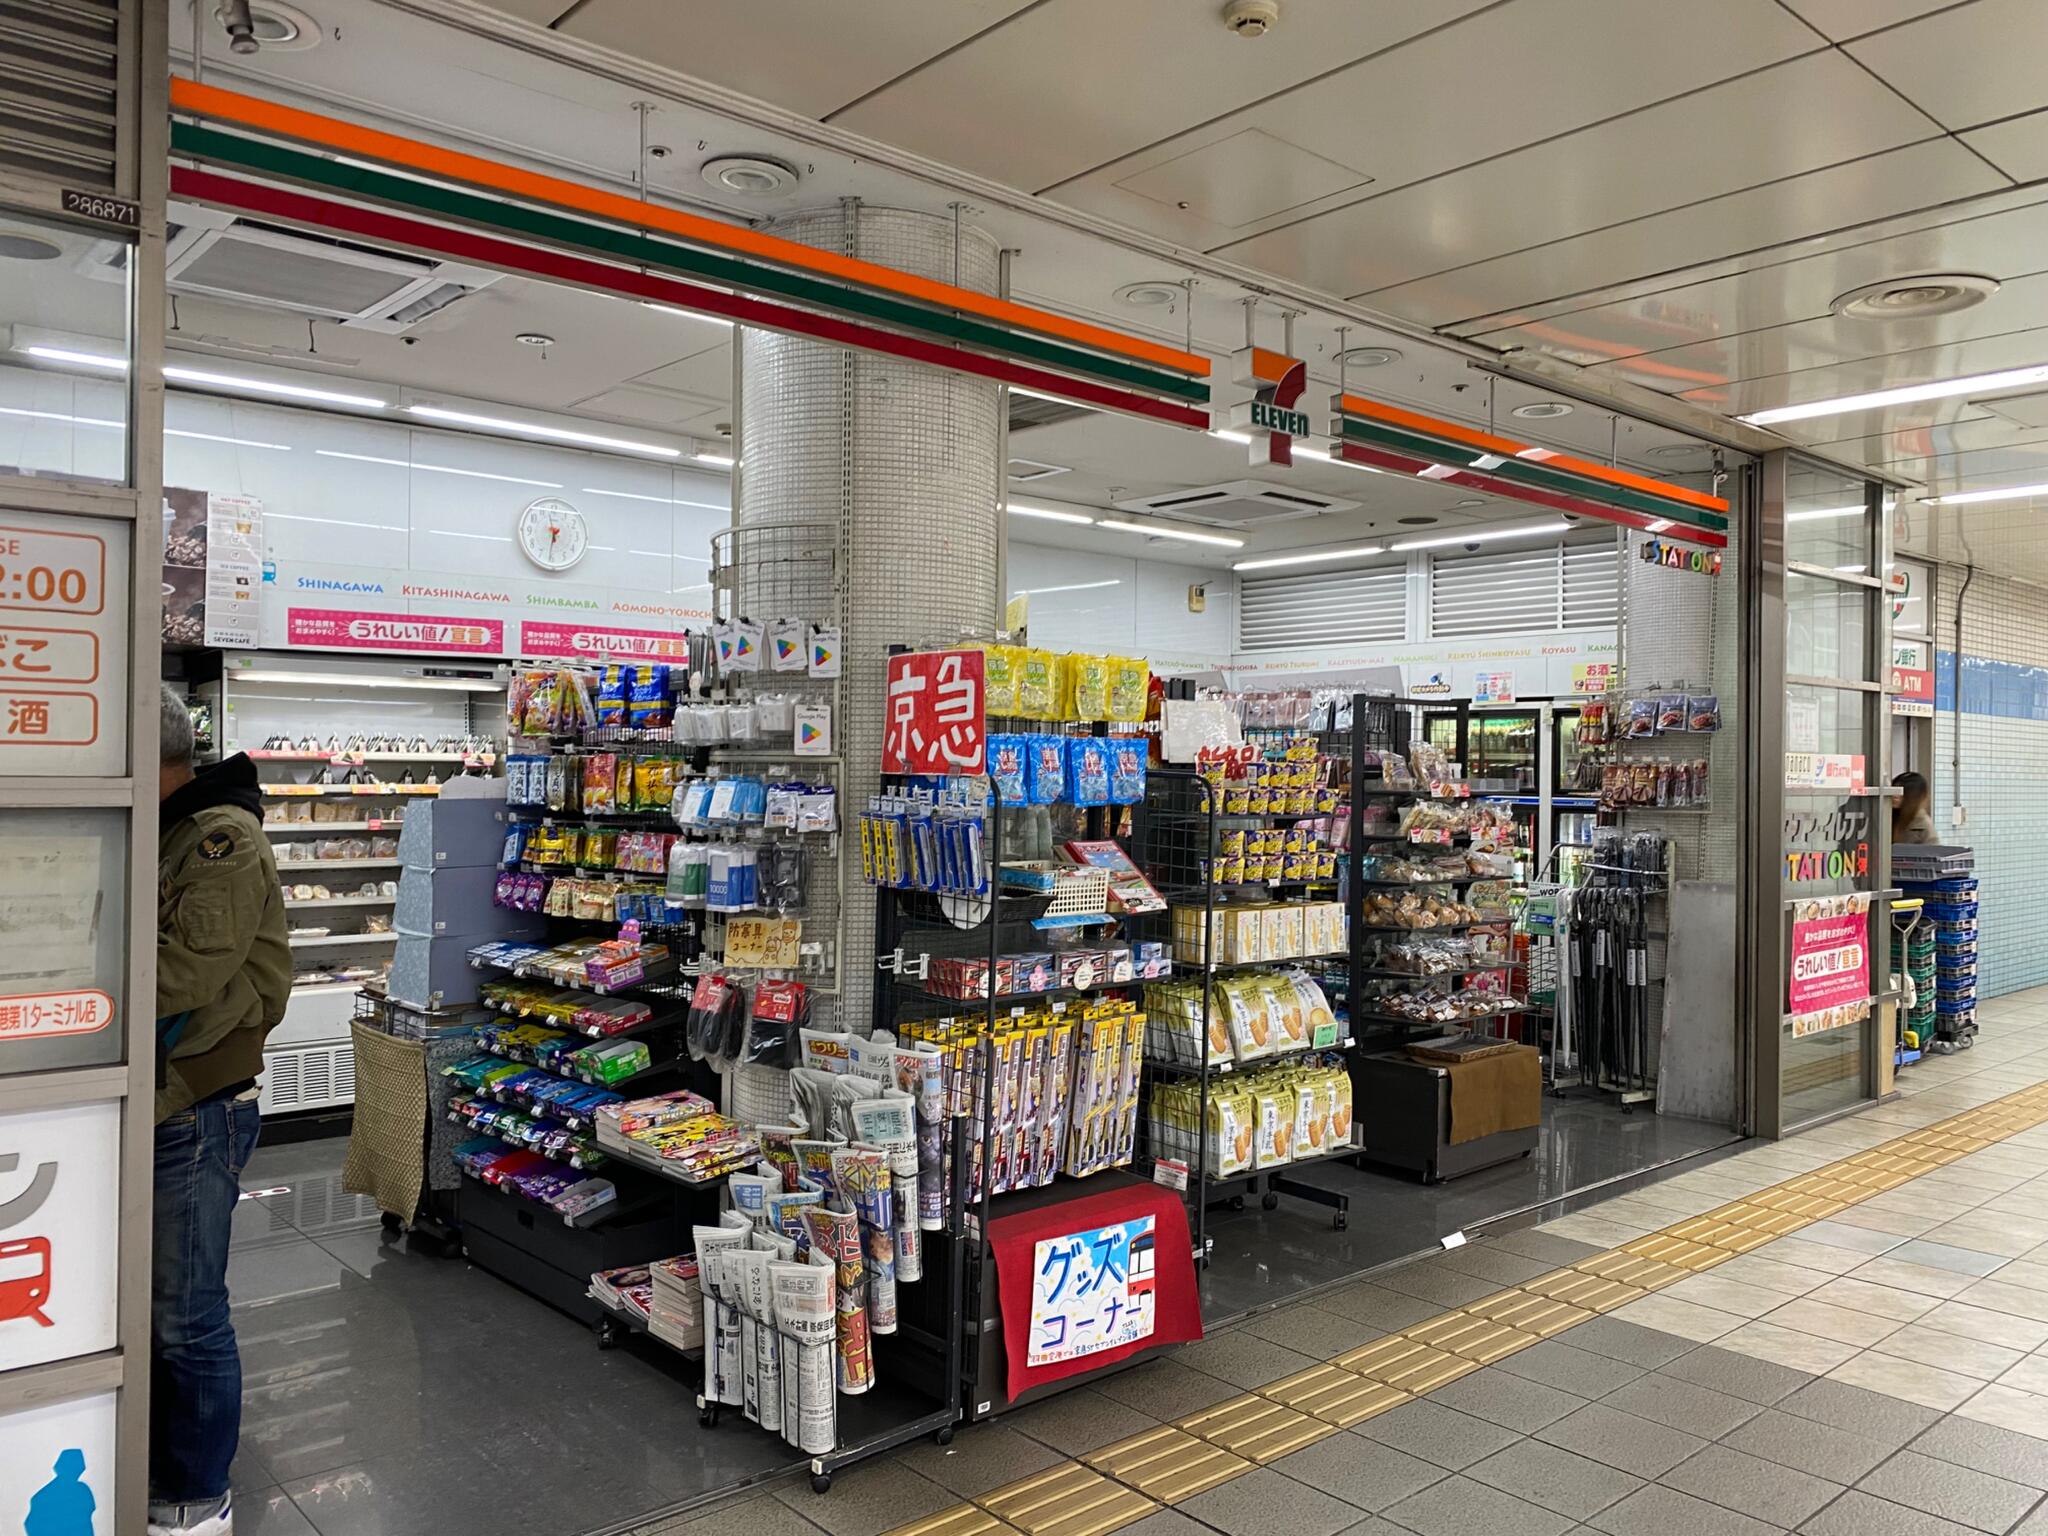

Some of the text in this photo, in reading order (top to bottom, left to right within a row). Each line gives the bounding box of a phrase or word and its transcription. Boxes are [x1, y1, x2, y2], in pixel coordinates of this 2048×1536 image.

[68, 194, 134, 223] 286871
[0, 565, 86, 604] :00
[297, 577, 385, 593] SHINAGAWA
[402, 584, 510, 603] KITASHINAGAWA
[526, 594, 599, 610] SHIMBAMBA
[0, 634, 51, 673] こ
[1541, 647, 1576, 655] KOYASU
[1904, 676, 1922, 693] ATM
[8, 699, 50, 734] 酒
[887, 655, 983, 768] 京急
[728, 922, 763, 939] 防寒具
[733, 942, 763, 951] コーナー
[1041, 1233, 1125, 1304] グッズ
[1041, 1296, 1141, 1348] コーナー
